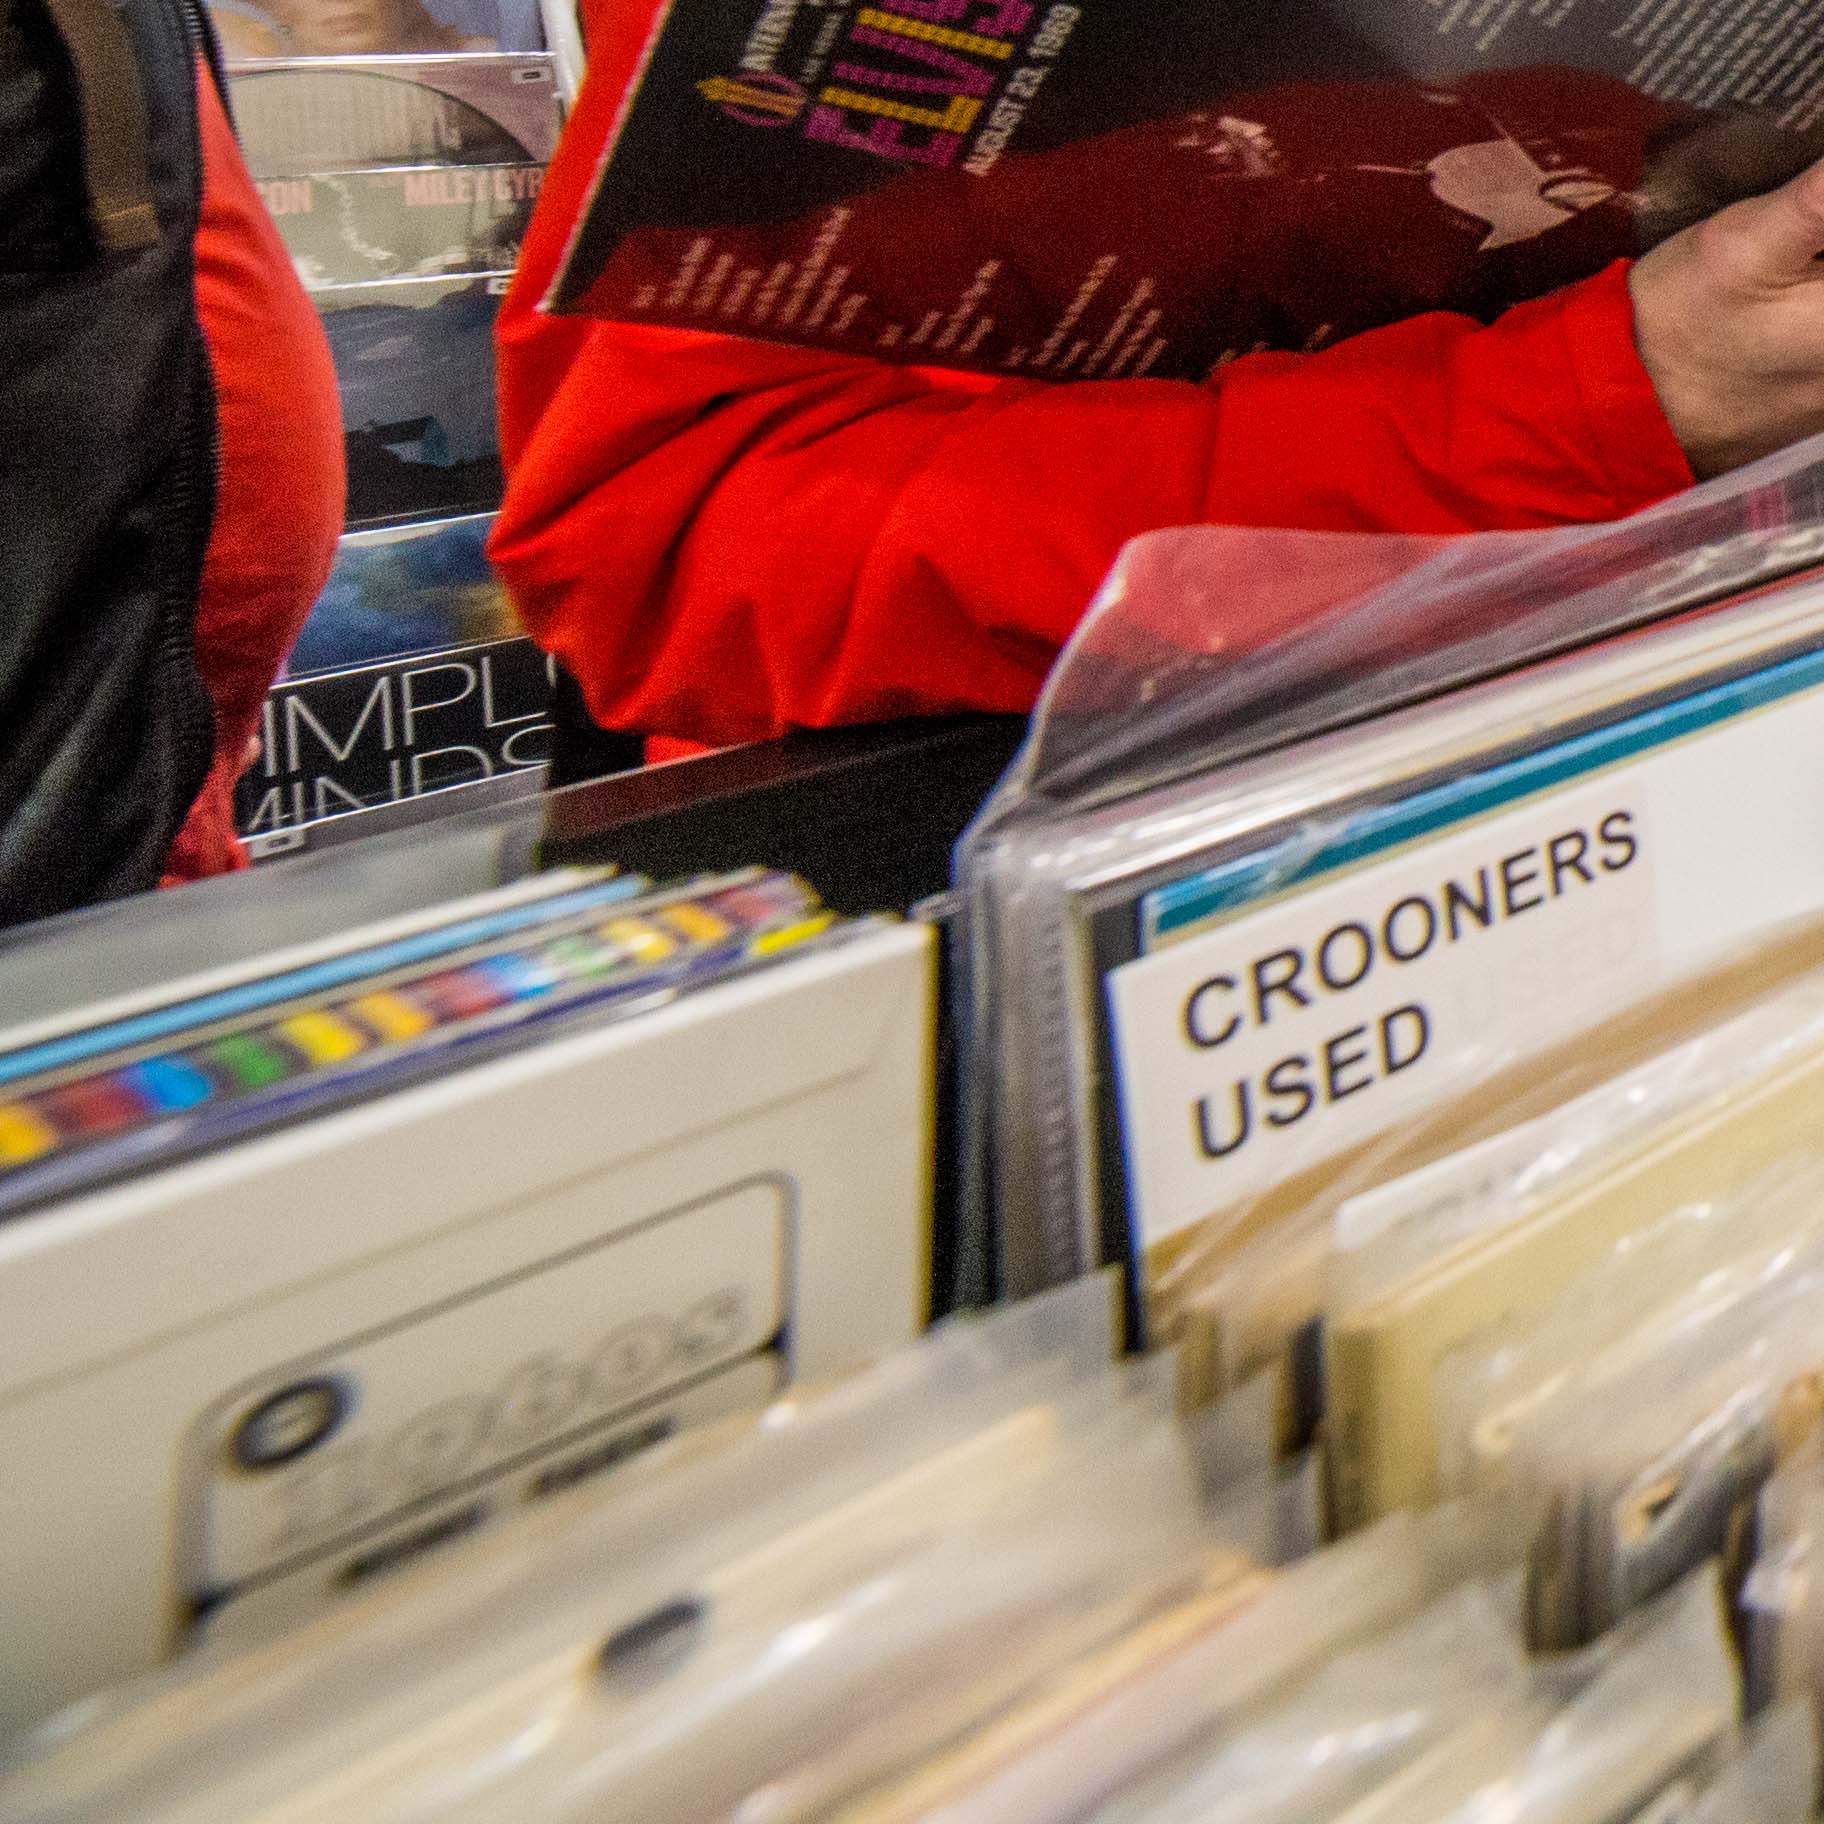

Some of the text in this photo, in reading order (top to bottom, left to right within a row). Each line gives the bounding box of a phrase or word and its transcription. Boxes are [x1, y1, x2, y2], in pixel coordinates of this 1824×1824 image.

[492, 167, 544, 202] CYR
[963, 95, 1027, 176] AUGUST
[263, 654, 557, 777] IMPL
[1181, 810, 1640, 1051] CROONERS
[1190, 1002, 1432, 1162] USED
